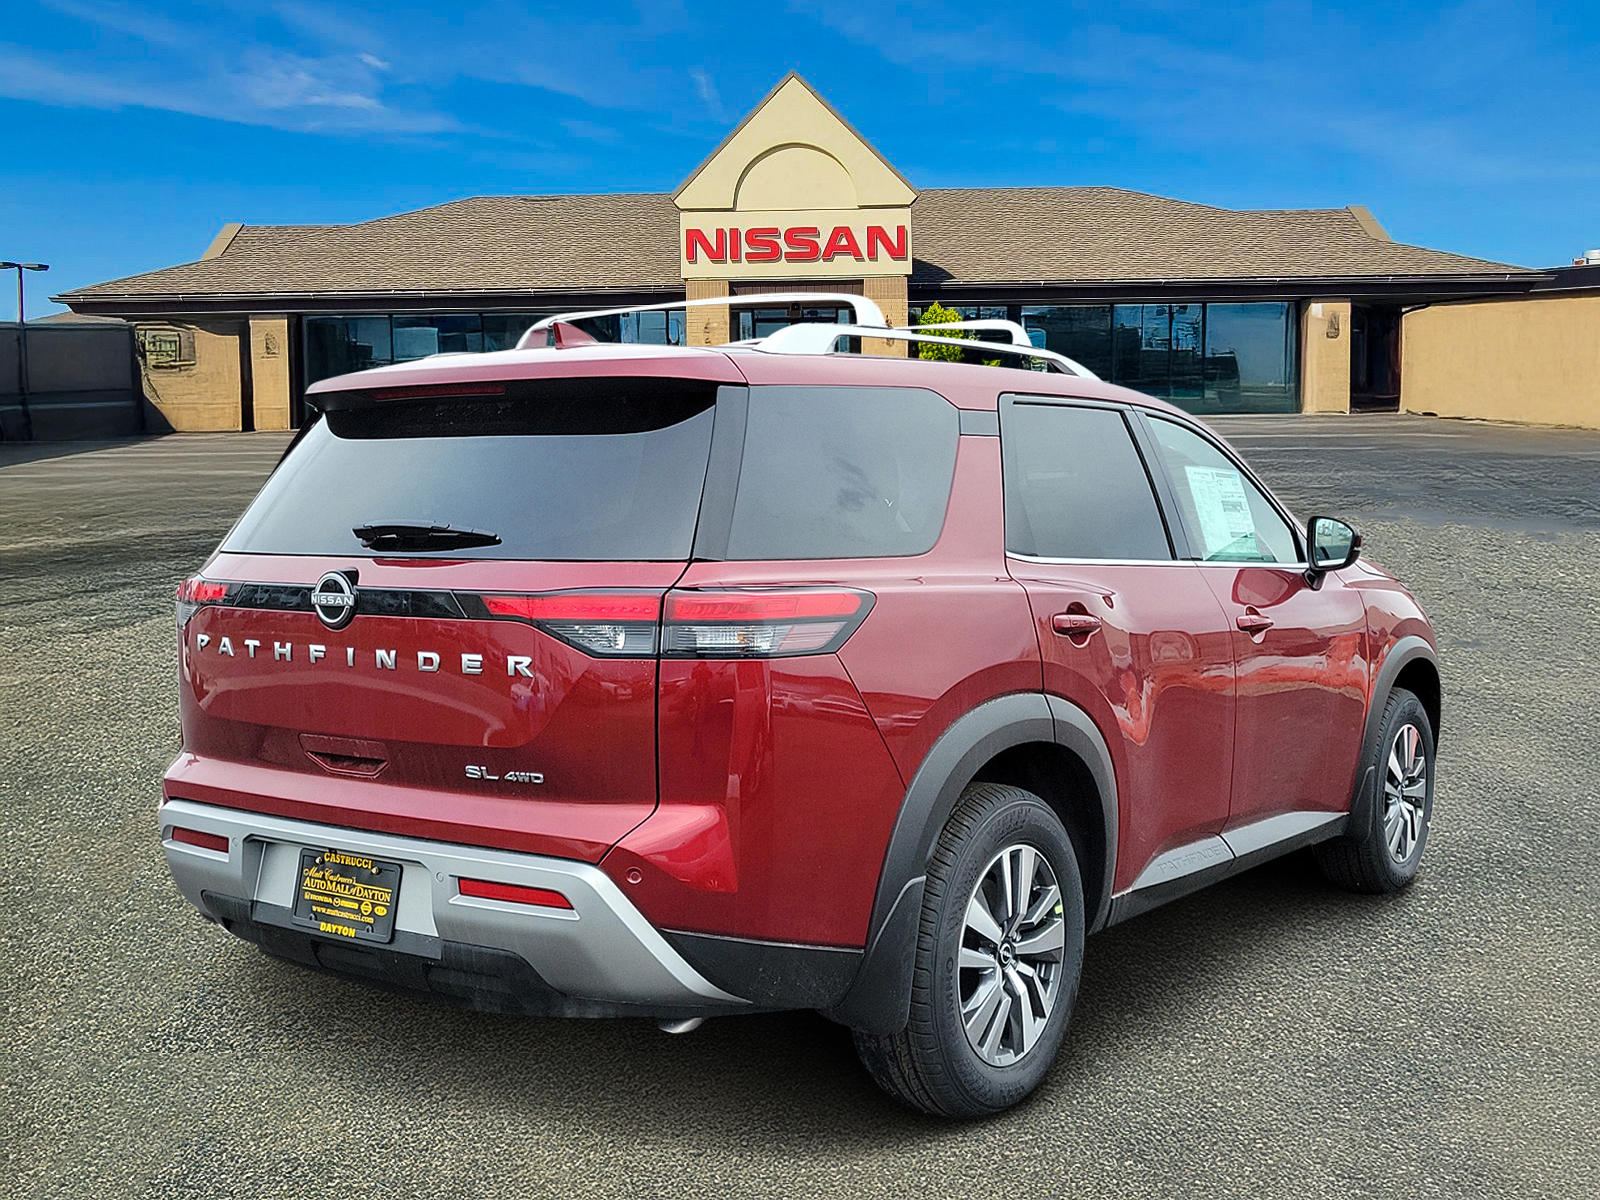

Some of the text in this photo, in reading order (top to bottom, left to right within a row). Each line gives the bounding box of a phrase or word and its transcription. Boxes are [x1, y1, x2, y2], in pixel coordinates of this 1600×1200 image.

[685, 225, 908, 264] NISSAN
[311, 595, 352, 605] NISSAN
[196, 632, 535, 678] PATHFINDER
[465, 765, 544, 784] SL 4WD
[323, 852, 372, 869] CASTRUCCI
[1157, 844, 1230, 874] PATHFINDER
[310, 893, 333, 904] HONDA
[355, 885, 391, 902] DAYTON
[320, 921, 356, 938] DAYTON
